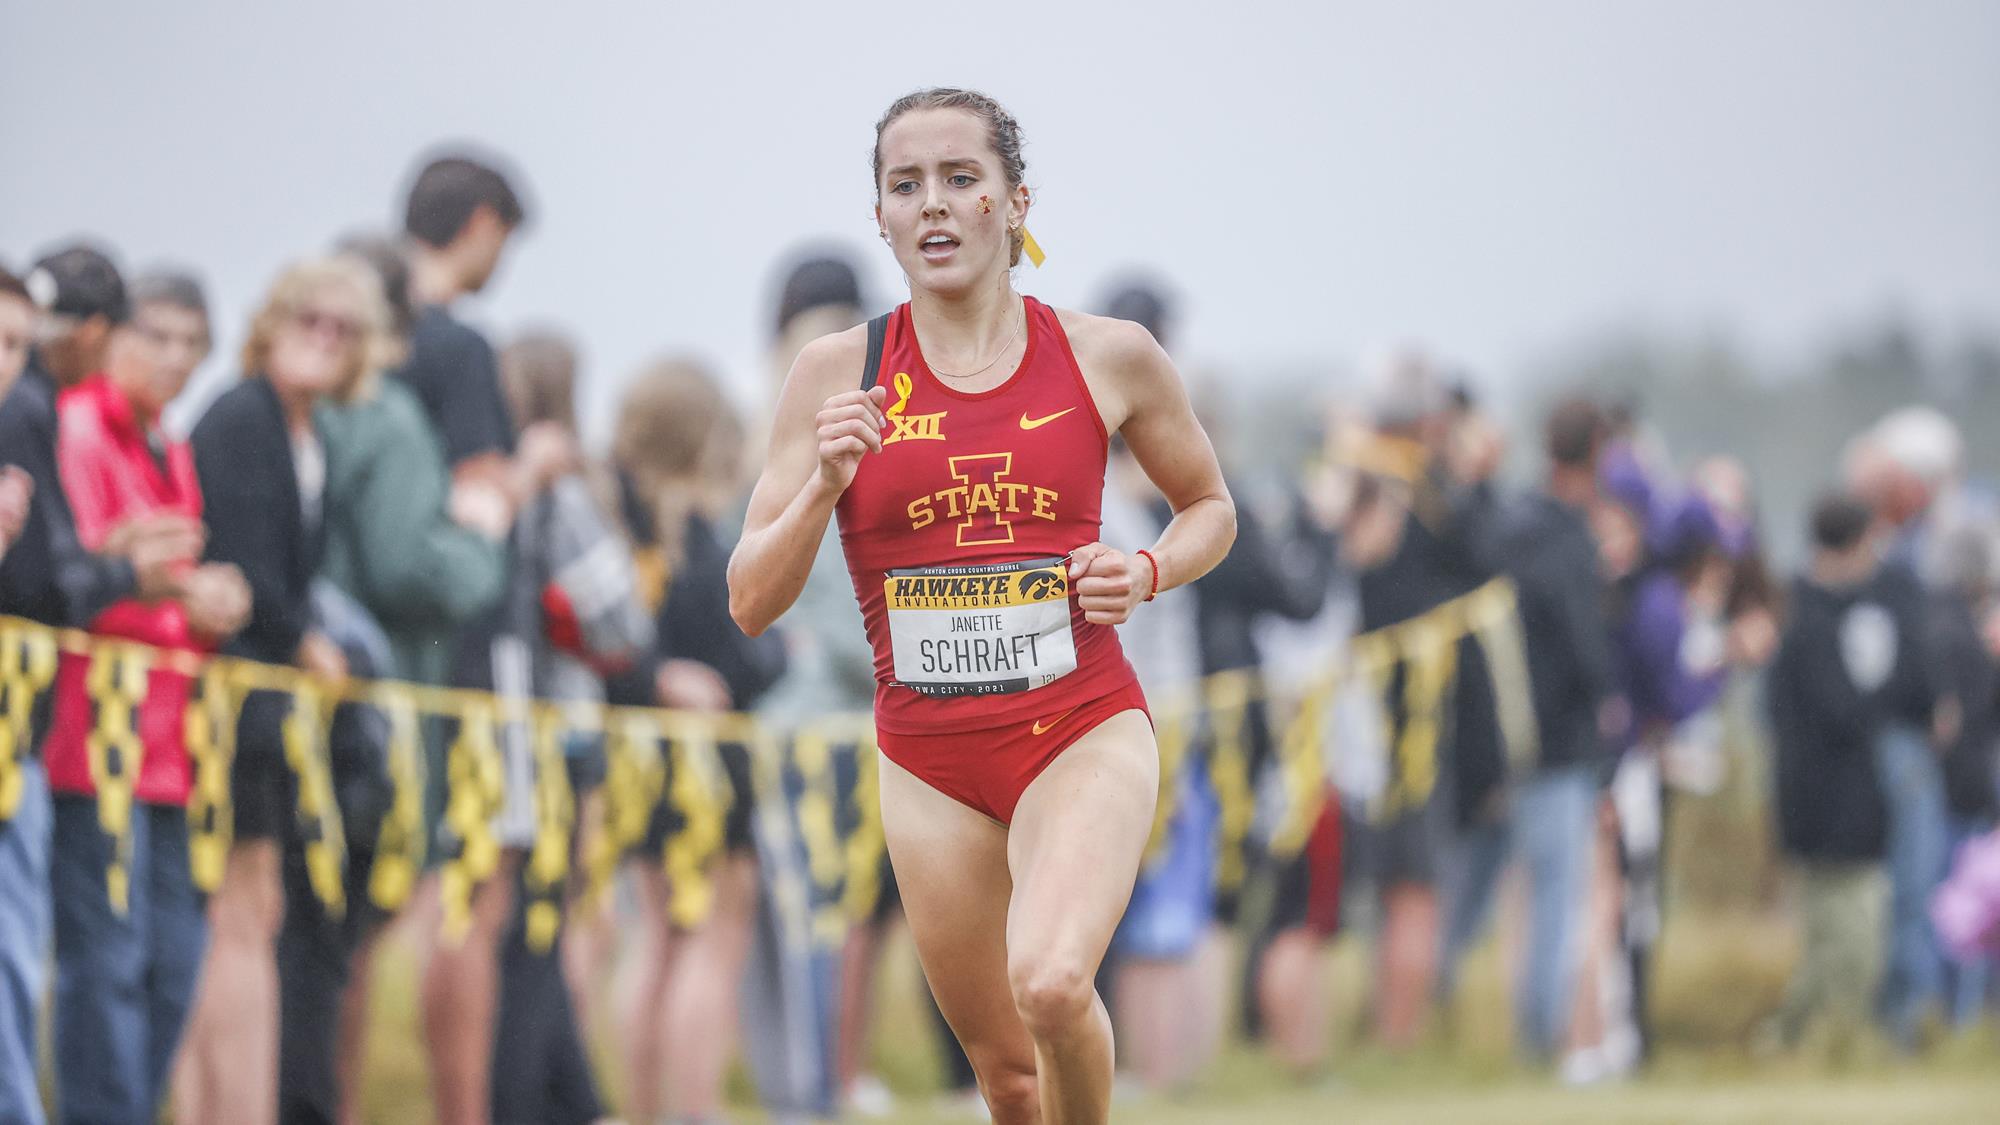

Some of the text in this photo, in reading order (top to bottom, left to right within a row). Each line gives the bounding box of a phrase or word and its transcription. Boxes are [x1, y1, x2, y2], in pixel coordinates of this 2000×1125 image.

[882, 410, 948, 446] XII
[907, 483, 1059, 530] STATE
[968, 566, 995, 574] COUNTRY
[996, 563, 1020, 572] COURSE
[894, 575, 1012, 597] HAWKEYE
[895, 593, 1011, 608] INVITATIONAL
[950, 614, 1003, 633] JANETTE
[920, 632, 1040, 673] SCHRAFT
[941, 685, 966, 694] CITY
[977, 684, 1005, 693] 2021
